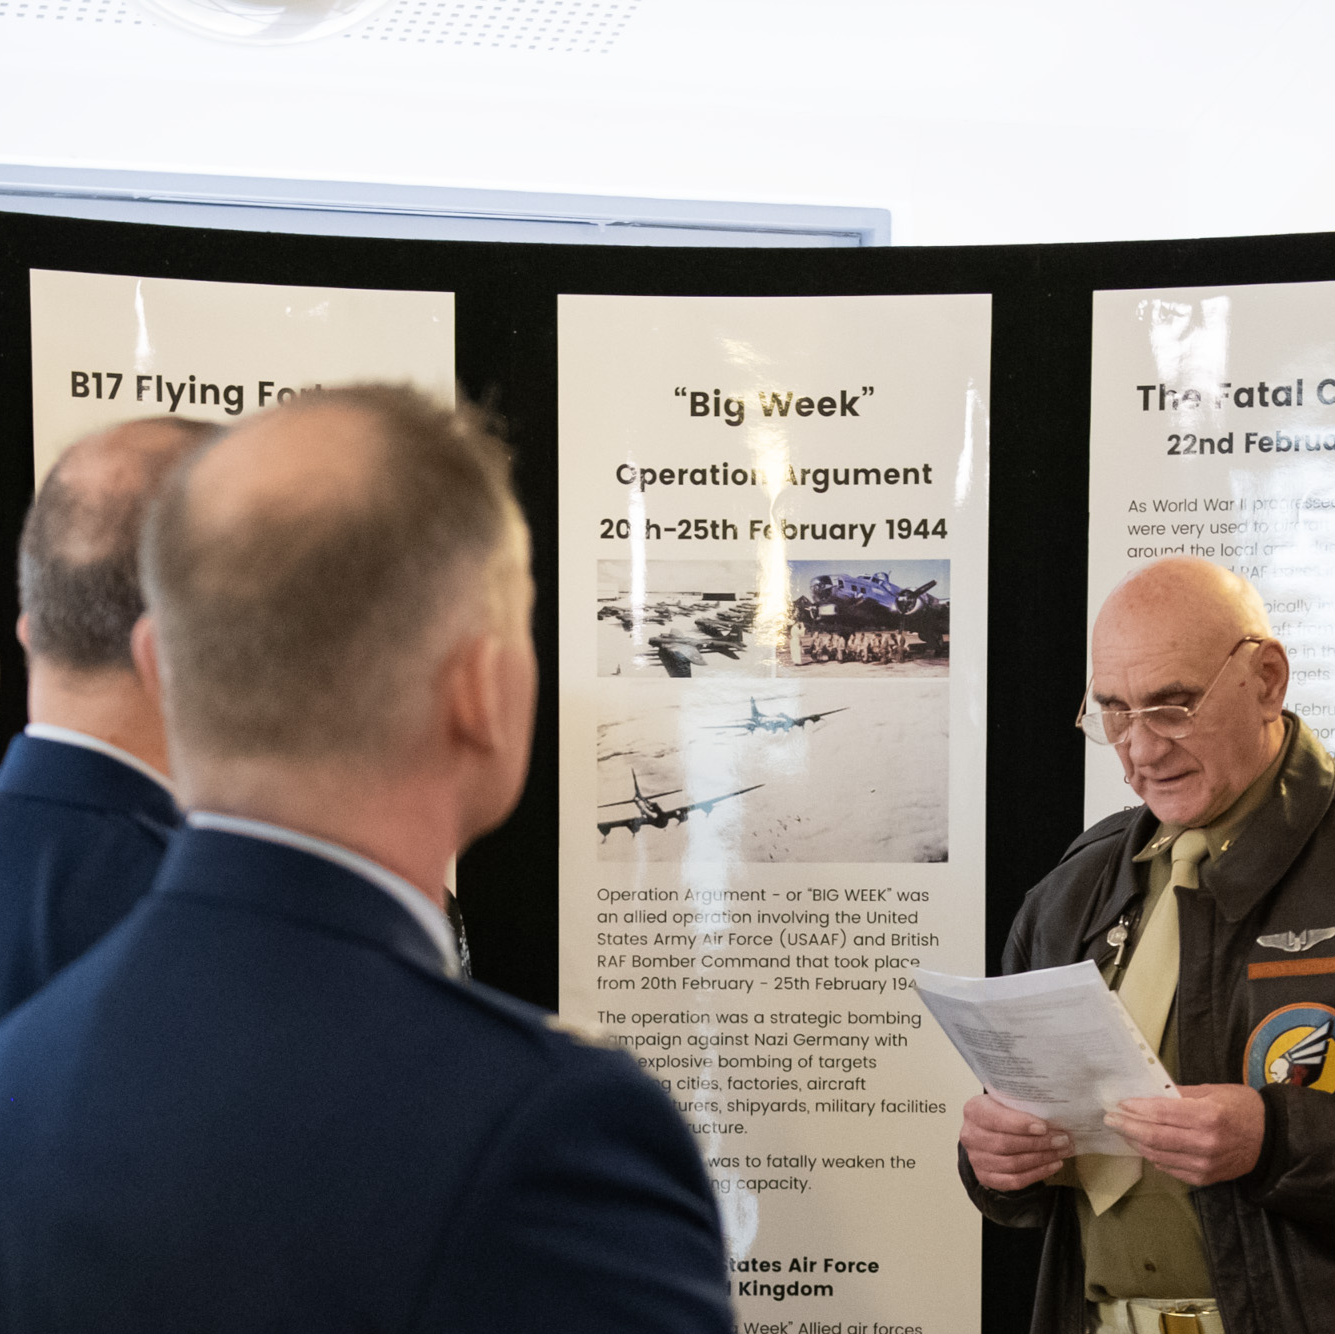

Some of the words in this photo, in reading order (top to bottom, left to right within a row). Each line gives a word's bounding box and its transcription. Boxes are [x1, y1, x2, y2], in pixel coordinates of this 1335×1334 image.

[71, 371, 123, 399] B17
[137, 375, 243, 415] Flying
[675, 387, 744, 426] “Big
[759, 386, 874, 417] Week”
[1167, 432, 1233, 455] 22nd
[1128, 500, 1146, 512] As
[1153, 498, 1197, 512] World
[1204, 499, 1234, 511] War
[600, 519, 737, 540] 20h-25th
[886, 518, 947, 539] 1944
[597, 888, 678, 905] Operation
[684, 889, 766, 902] Argument
[786, 891, 802, 901] or
[897, 892, 929, 901] was
[597, 913, 618, 923] an
[624, 910, 667, 923] allied
[673, 910, 751, 927] operation
[758, 910, 829, 928] involving
[835, 911, 861, 924] the
[867, 911, 918, 924] United
[598, 933, 647, 945] States
[654, 933, 696, 949] Army
[703, 932, 723, 944] Air
[729, 933, 773, 945] Force
[780, 928, 846, 948] (USAAF)
[853, 933, 885, 946] and
[892, 933, 939, 946] British
[598, 955, 626, 967] RAF
[632, 955, 696, 968] Bomber
[701, 955, 790, 968] Command
[796, 955, 829, 968] that
[834, 955, 868, 968] took
[875, 955, 920, 972] place
[597, 976, 635, 989] from
[641, 977, 676, 989] 20th
[683, 977, 753, 994] February
[774, 977, 809, 990] 25th
[816, 977, 887, 994] February
[893, 977, 918, 990] 194
[598, 1011, 626, 1023] The
[632, 1010, 710, 1028] operation
[716, 1014, 748, 1024] was
[754, 1014, 764, 1024] a
[770, 1011, 842, 1028] strategic
[848, 1011, 921, 1029] bombing
[609, 1033, 681, 1050] ampaign
[687, 1032, 749, 1050] against
[755, 1033, 787, 1046] Nazi
[793, 1034, 869, 1050] Germany
[875, 1033, 907, 1046] with
[710, 1157, 739, 1167] was
[745, 1155, 761, 1167] to
[767, 1154, 817, 1172] fatally
[822, 1155, 884, 1168] weaken
[890, 1156, 916, 1169] the
[737, 1176, 811, 1194] capacity.
[730, 1258, 782, 1273] tates
[789, 1256, 817, 1272] Air
[824, 1258, 879, 1273] Force
[739, 1280, 833, 1301] Kingdom
[744, 1321, 793, 1334] Week”
[798, 1322, 841, 1334] Allied
[847, 1322, 868, 1334] air
